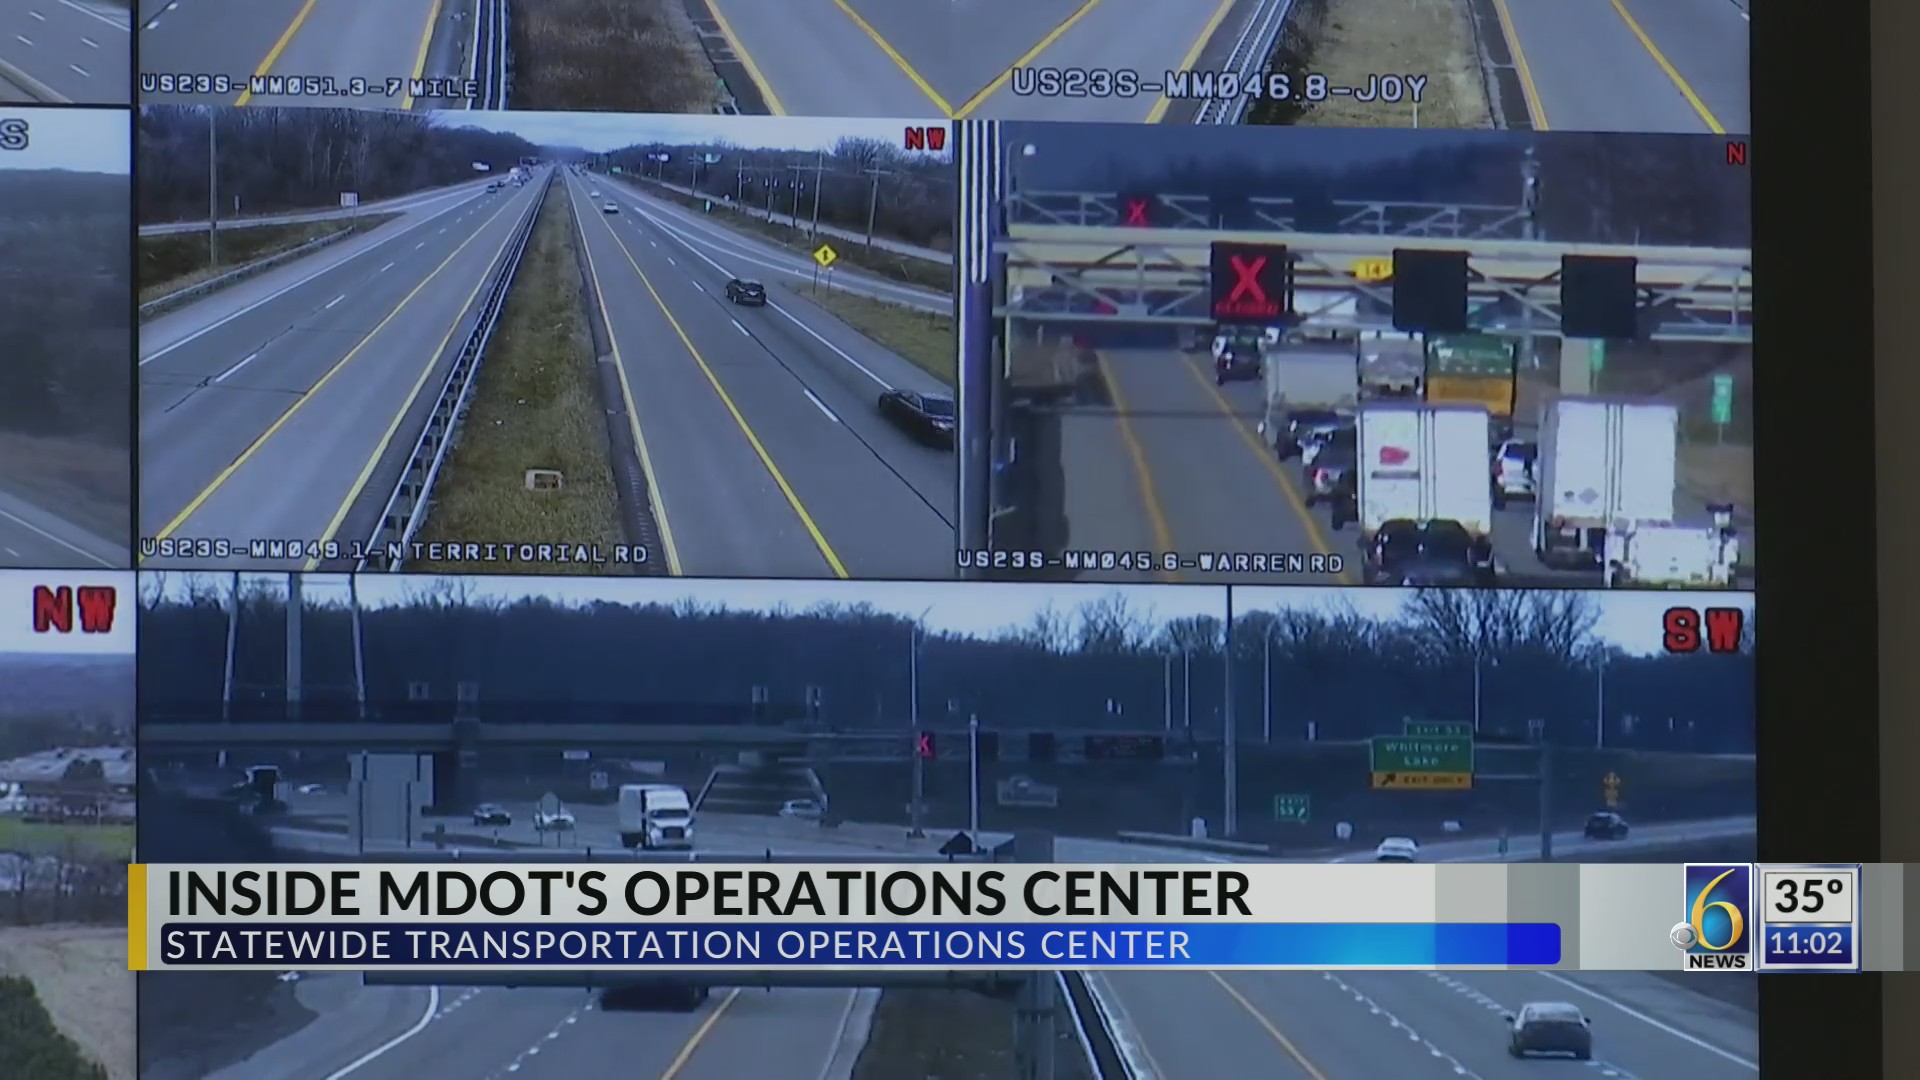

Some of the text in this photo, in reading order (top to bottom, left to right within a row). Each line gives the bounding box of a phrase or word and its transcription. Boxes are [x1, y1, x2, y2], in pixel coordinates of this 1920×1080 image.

[408, 78, 480, 98] MILE
[905, 127, 945, 150] NW
[1727, 141, 1745, 165] N
[411, 542, 606, 562] TERRITORIAL
[614, 544, 648, 563] RD
[1310, 554, 1343, 573] RD
[33, 585, 116, 633] NW
[1663, 607, 1743, 653] SW
[1385, 741, 1460, 753] Whitmore
[1404, 755, 1440, 767] Lake
